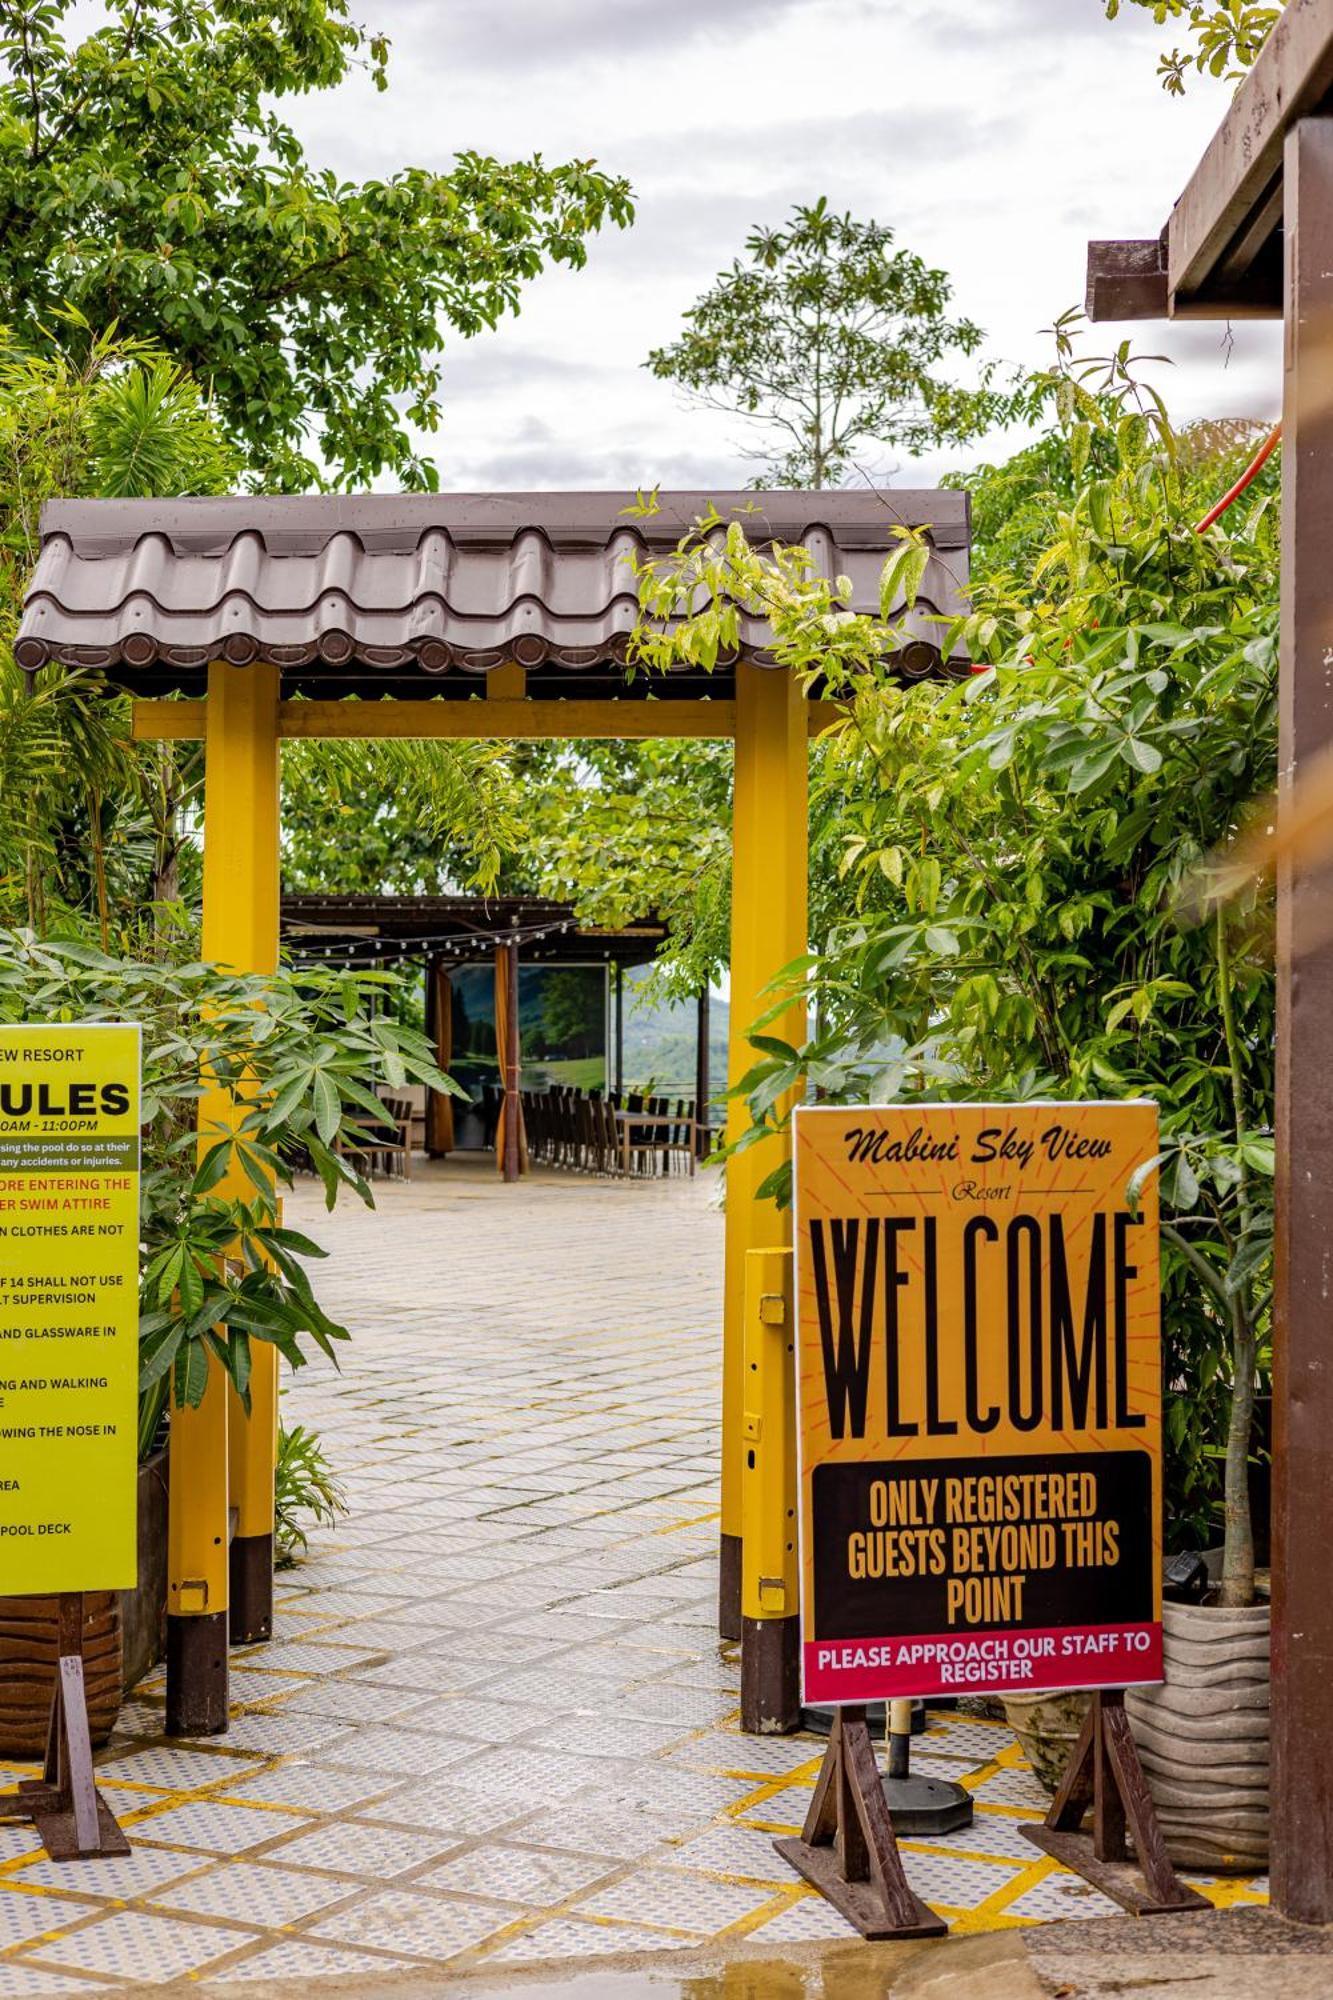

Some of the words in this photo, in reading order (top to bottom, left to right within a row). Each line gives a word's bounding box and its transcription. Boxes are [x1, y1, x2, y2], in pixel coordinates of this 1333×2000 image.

[23, 1049, 85, 1062] RESORT
[41, 1120, 98, 1132] 11:00PM
[23, 1143, 40, 1152] the
[42, 1143, 64, 1153] pool
[66, 1143, 79, 1152] do
[94, 1144, 105, 1152] at
[106, 1142, 130, 1152] their
[843, 1125, 961, 1165] Mabini
[970, 1127, 1035, 1170] Sky
[1039, 1125, 1113, 1160] View
[20, 1157, 69, 1167] accidents
[70, 1158, 82, 1166] or
[83, 1156, 122, 1168] injuries.
[29, 1178, 100, 1190] ENTERING
[104, 1178, 131, 1190] THE
[950, 1179, 1013, 1202] Resort
[20, 1199, 58, 1210] SWIM
[62, 1198, 110, 1210] ATTIRE
[11, 1226, 68, 1237] CLOTHES
[71, 1225, 95, 1235] ARE
[98, 1224, 124, 1235] NOT
[10, 1278, 24, 1287] 14
[27, 1276, 67, 1288] SHALL
[70, 1276, 96, 1287] NOT
[99, 1275, 123, 1286] USE
[12, 1293, 96, 1304] SUPERVISION
[808, 1211, 1148, 1440] WELCOME
[24, 1327, 100, 1339] GLASSWARE
[103, 1326, 116, 1336] IN
[20, 1379, 47, 1390] AND
[51, 1377, 108, 1389] WALKING
[39, 1426, 63, 1437] THE
[66, 1424, 100, 1436] NOSE
[103, 1424, 117, 1435] IN
[868, 1478, 939, 1528] ONLY
[945, 1472, 1098, 1524] REGISTERED
[0, 1525, 35, 1536] POOL
[38, 1523, 71, 1535] DECK
[847, 1528, 947, 1580] GUESTS
[951, 1523, 1057, 1574] BEYOND
[1060, 1520, 1121, 1568] THIS
[947, 1575, 1026, 1625] POINT
[817, 1647, 892, 1671] PLEASE
[895, 1639, 1009, 1666] APPROACH
[1012, 1637, 1056, 1659] OUR
[1062, 1633, 1120, 1655] STAFF
[1123, 1631, 1152, 1652] TO
[940, 1659, 1034, 1684] REGISTER
